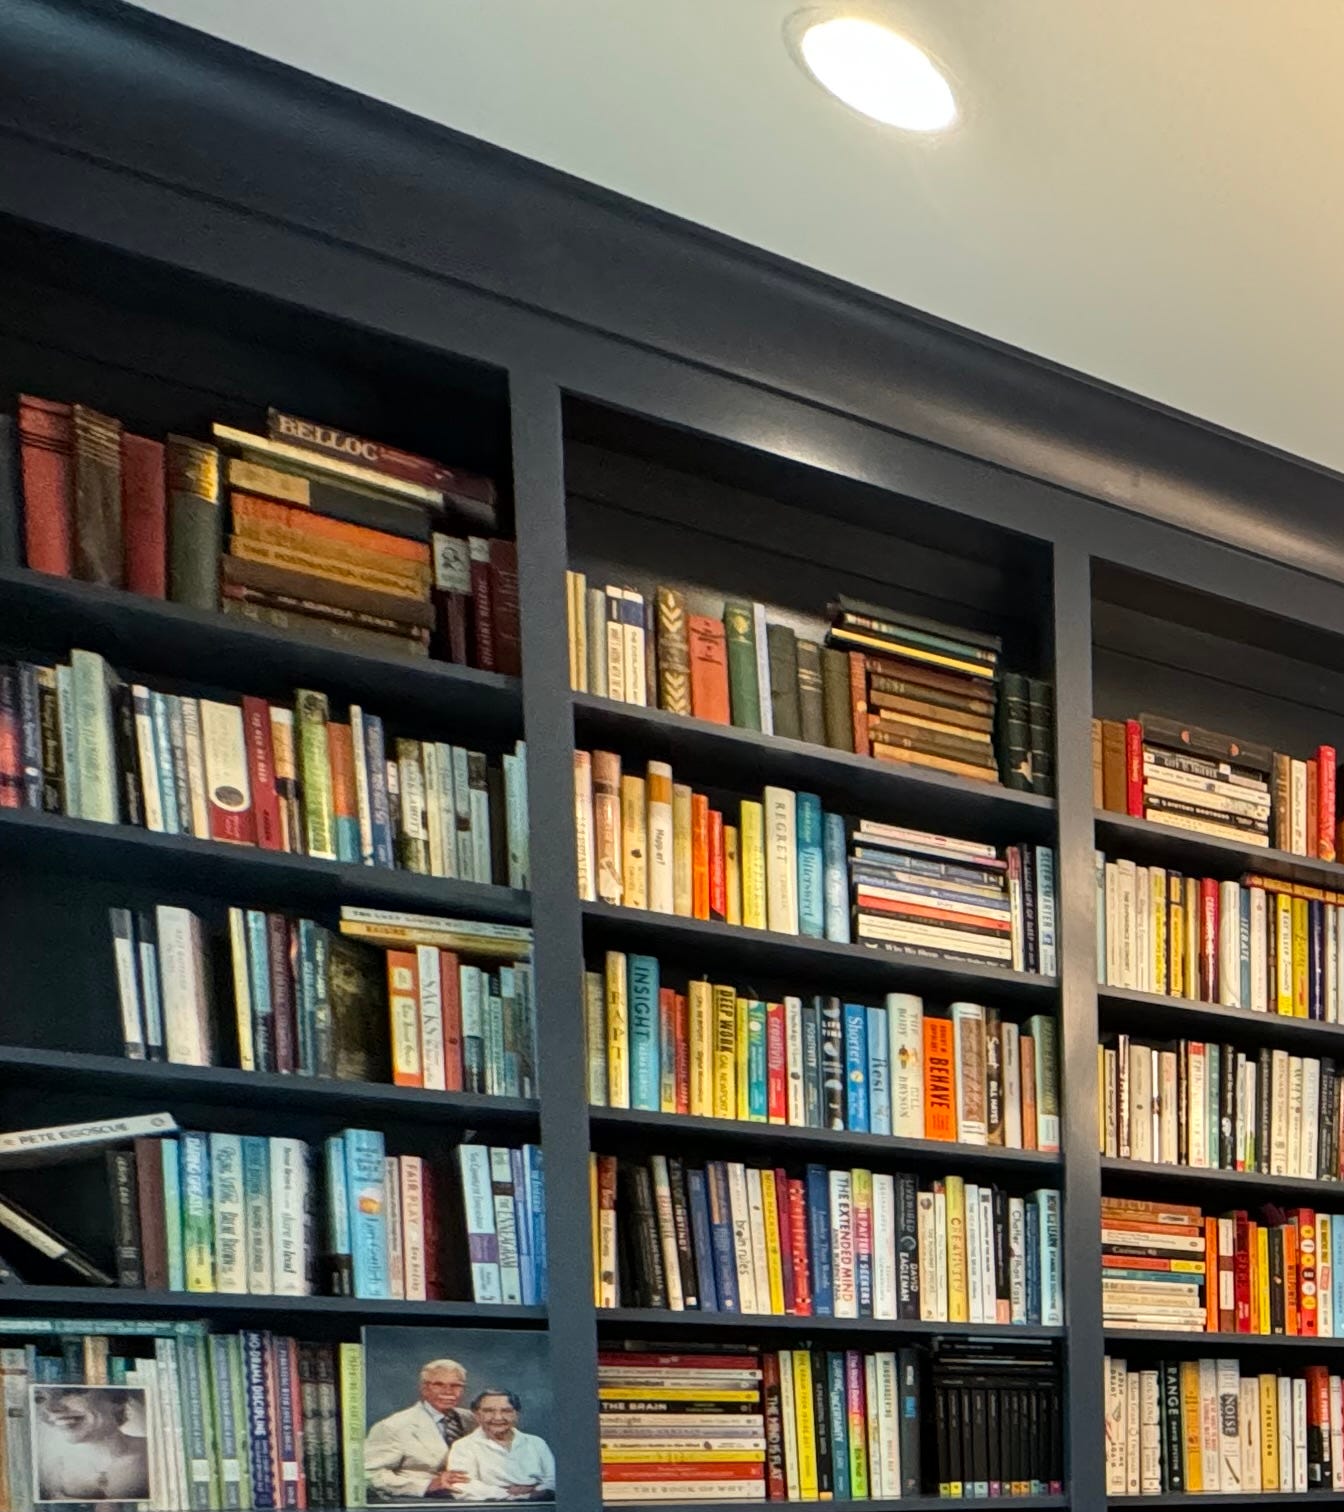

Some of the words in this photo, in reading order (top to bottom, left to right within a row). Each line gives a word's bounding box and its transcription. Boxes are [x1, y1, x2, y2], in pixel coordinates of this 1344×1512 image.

[277, 413, 381, 461] BELLOC
[774, 801, 788, 865] REGRET
[802, 848, 817, 918] Bittersweet
[1239, 916, 1251, 963] ITERATE
[633, 965, 651, 1041] INSIGHT
[719, 988, 735, 1016] DEEP
[719, 1018, 735, 1055] WORK
[846, 1014, 862, 1064] Shorter
[986, 1034, 1000, 1070] Sweat
[871, 1056, 888, 1093] Rest
[928, 1056, 951, 1110] BEHAVE
[989, 1098, 1000, 1126] HAYES
[18, 1128, 56, 1147] PETE
[404, 1158, 420, 1193] FAIR
[837, 1177, 850, 1199] THE
[405, 1195, 422, 1228] PLAY
[905, 1177, 916, 1233] LIVEWIRED
[838, 1201, 852, 1265] EXTENDED
[858, 1219, 870, 1262] PATTERN
[950, 1216, 962, 1293] CREATIVITY
[841, 1267, 853, 1303] MIND
[860, 1263, 873, 1306] SEEKERS
[908, 1263, 919, 1292] DAVID
[601, 1402, 625, 1411] THE
[629, 1402, 668, 1412] BRAIN
[1224, 1394, 1237, 1438] NOISE
